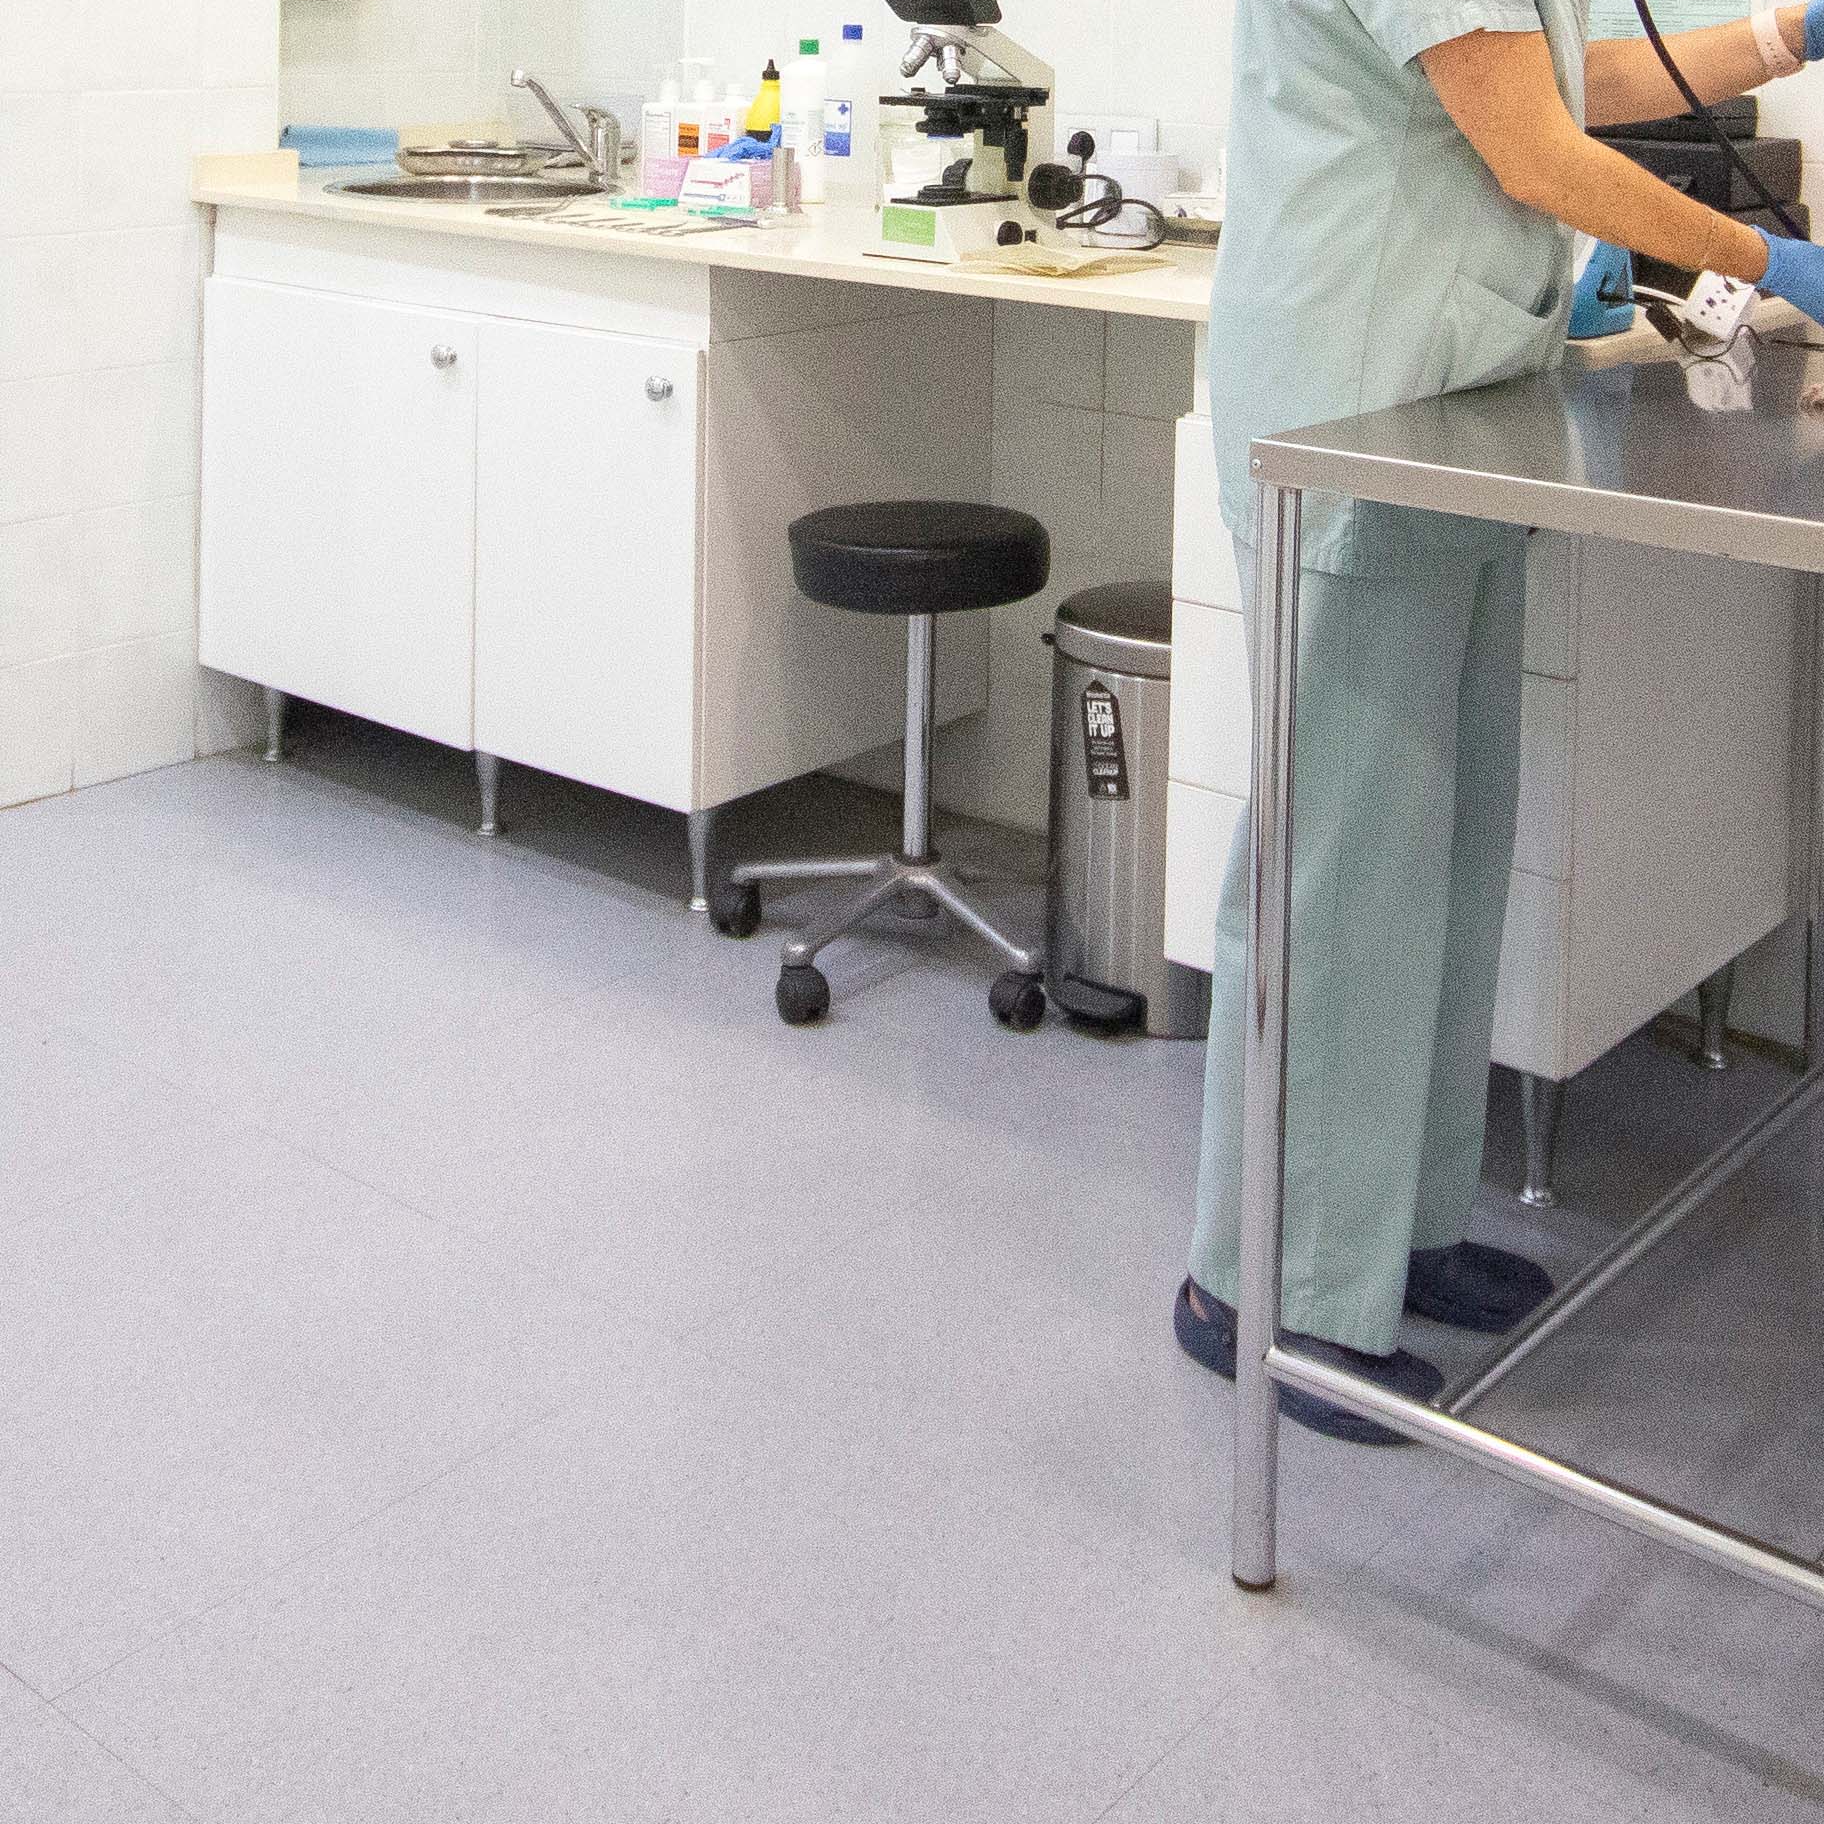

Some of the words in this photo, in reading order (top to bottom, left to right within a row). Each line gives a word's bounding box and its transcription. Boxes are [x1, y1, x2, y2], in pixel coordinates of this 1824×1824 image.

[1086, 701, 1113, 714] LET'S
[1088, 714, 1114, 724] CLEAN
[1088, 724, 1098, 737] IT
[1100, 724, 1116, 738] UP
